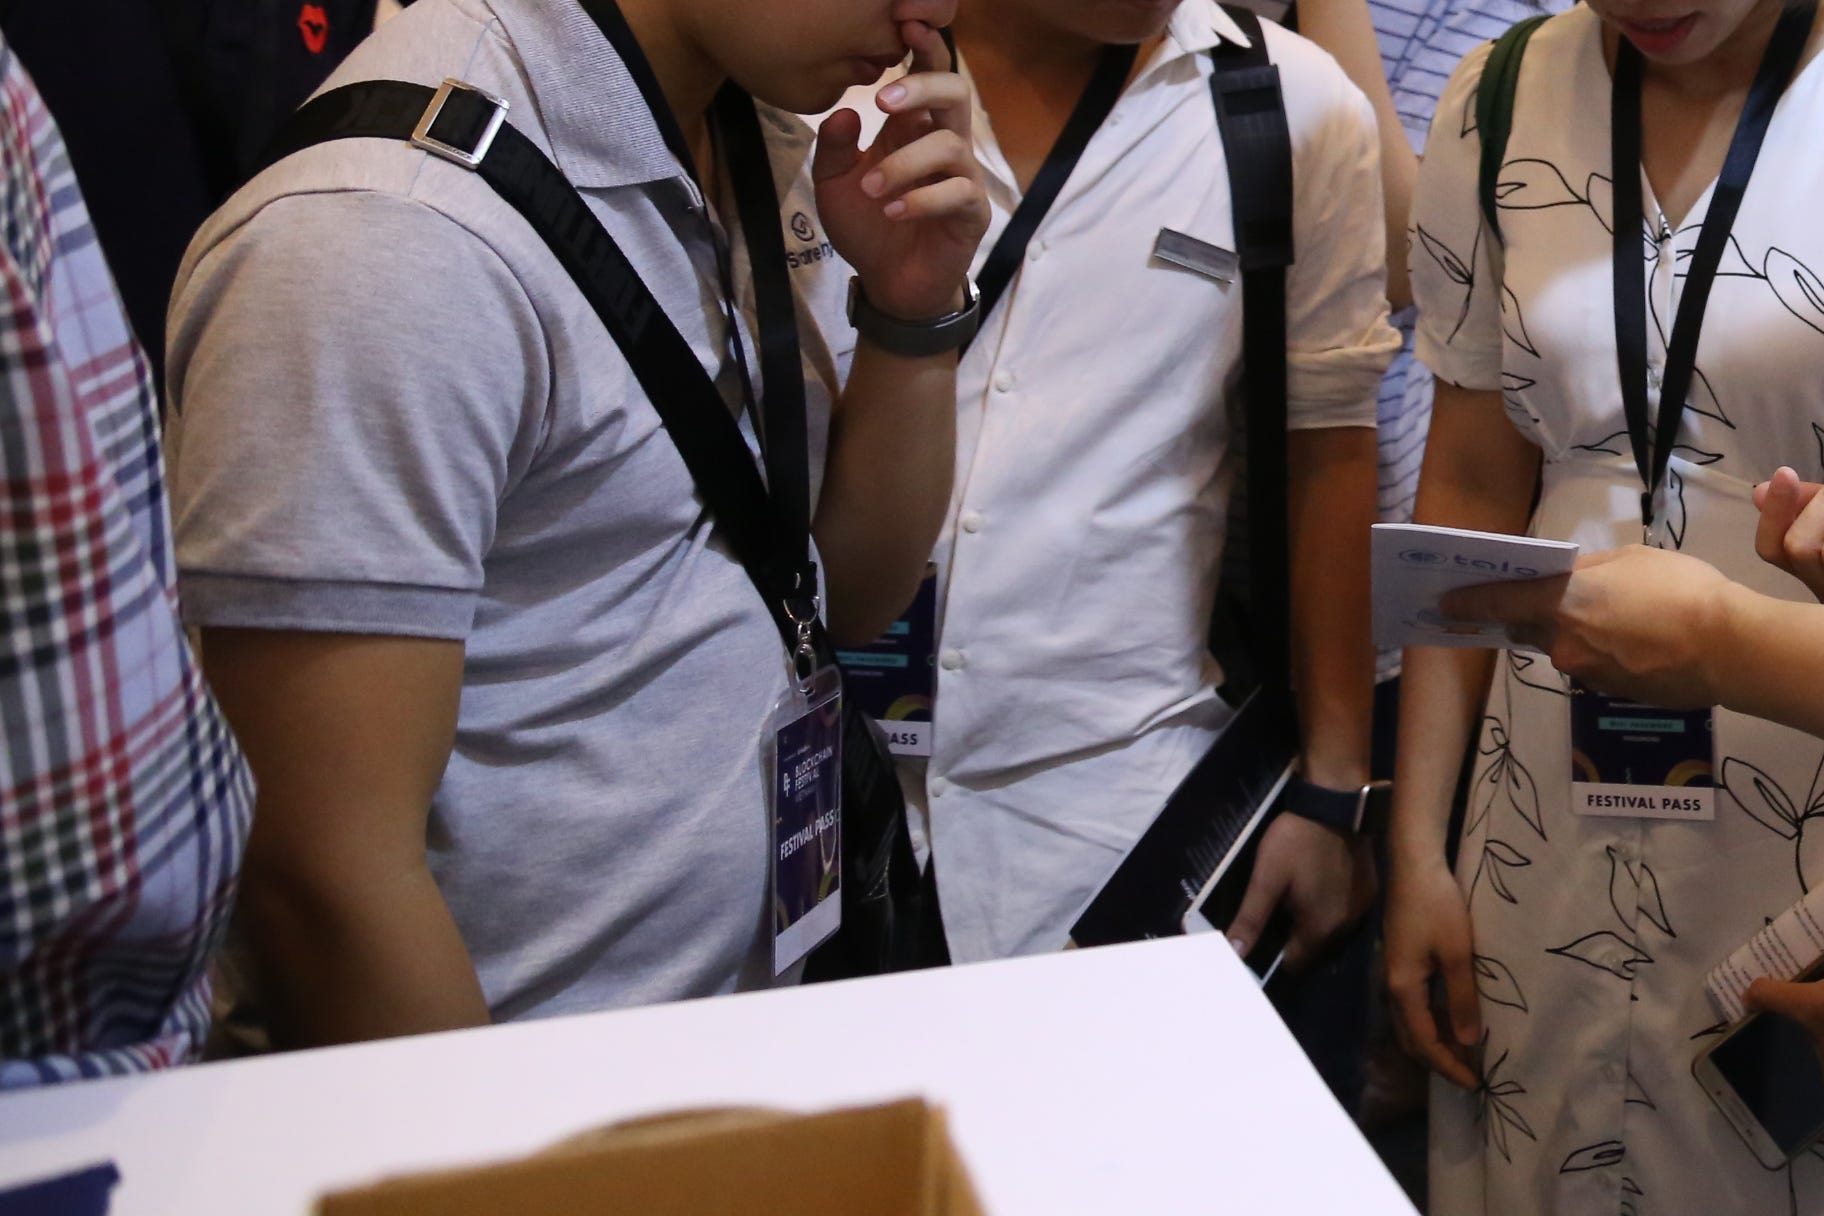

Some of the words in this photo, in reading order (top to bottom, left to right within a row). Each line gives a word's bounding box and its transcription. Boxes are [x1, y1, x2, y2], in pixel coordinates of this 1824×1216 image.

[889, 733, 918, 746] ASS
[795, 746, 833, 778] BLOCKCHAIN
[794, 767, 820, 792] FESTIVAL
[1587, 794, 1656, 809] FESTIVAL
[1662, 798, 1701, 811] PASS
[780, 824, 814, 861] FESTIVAL
[815, 809, 834, 836] PASS
